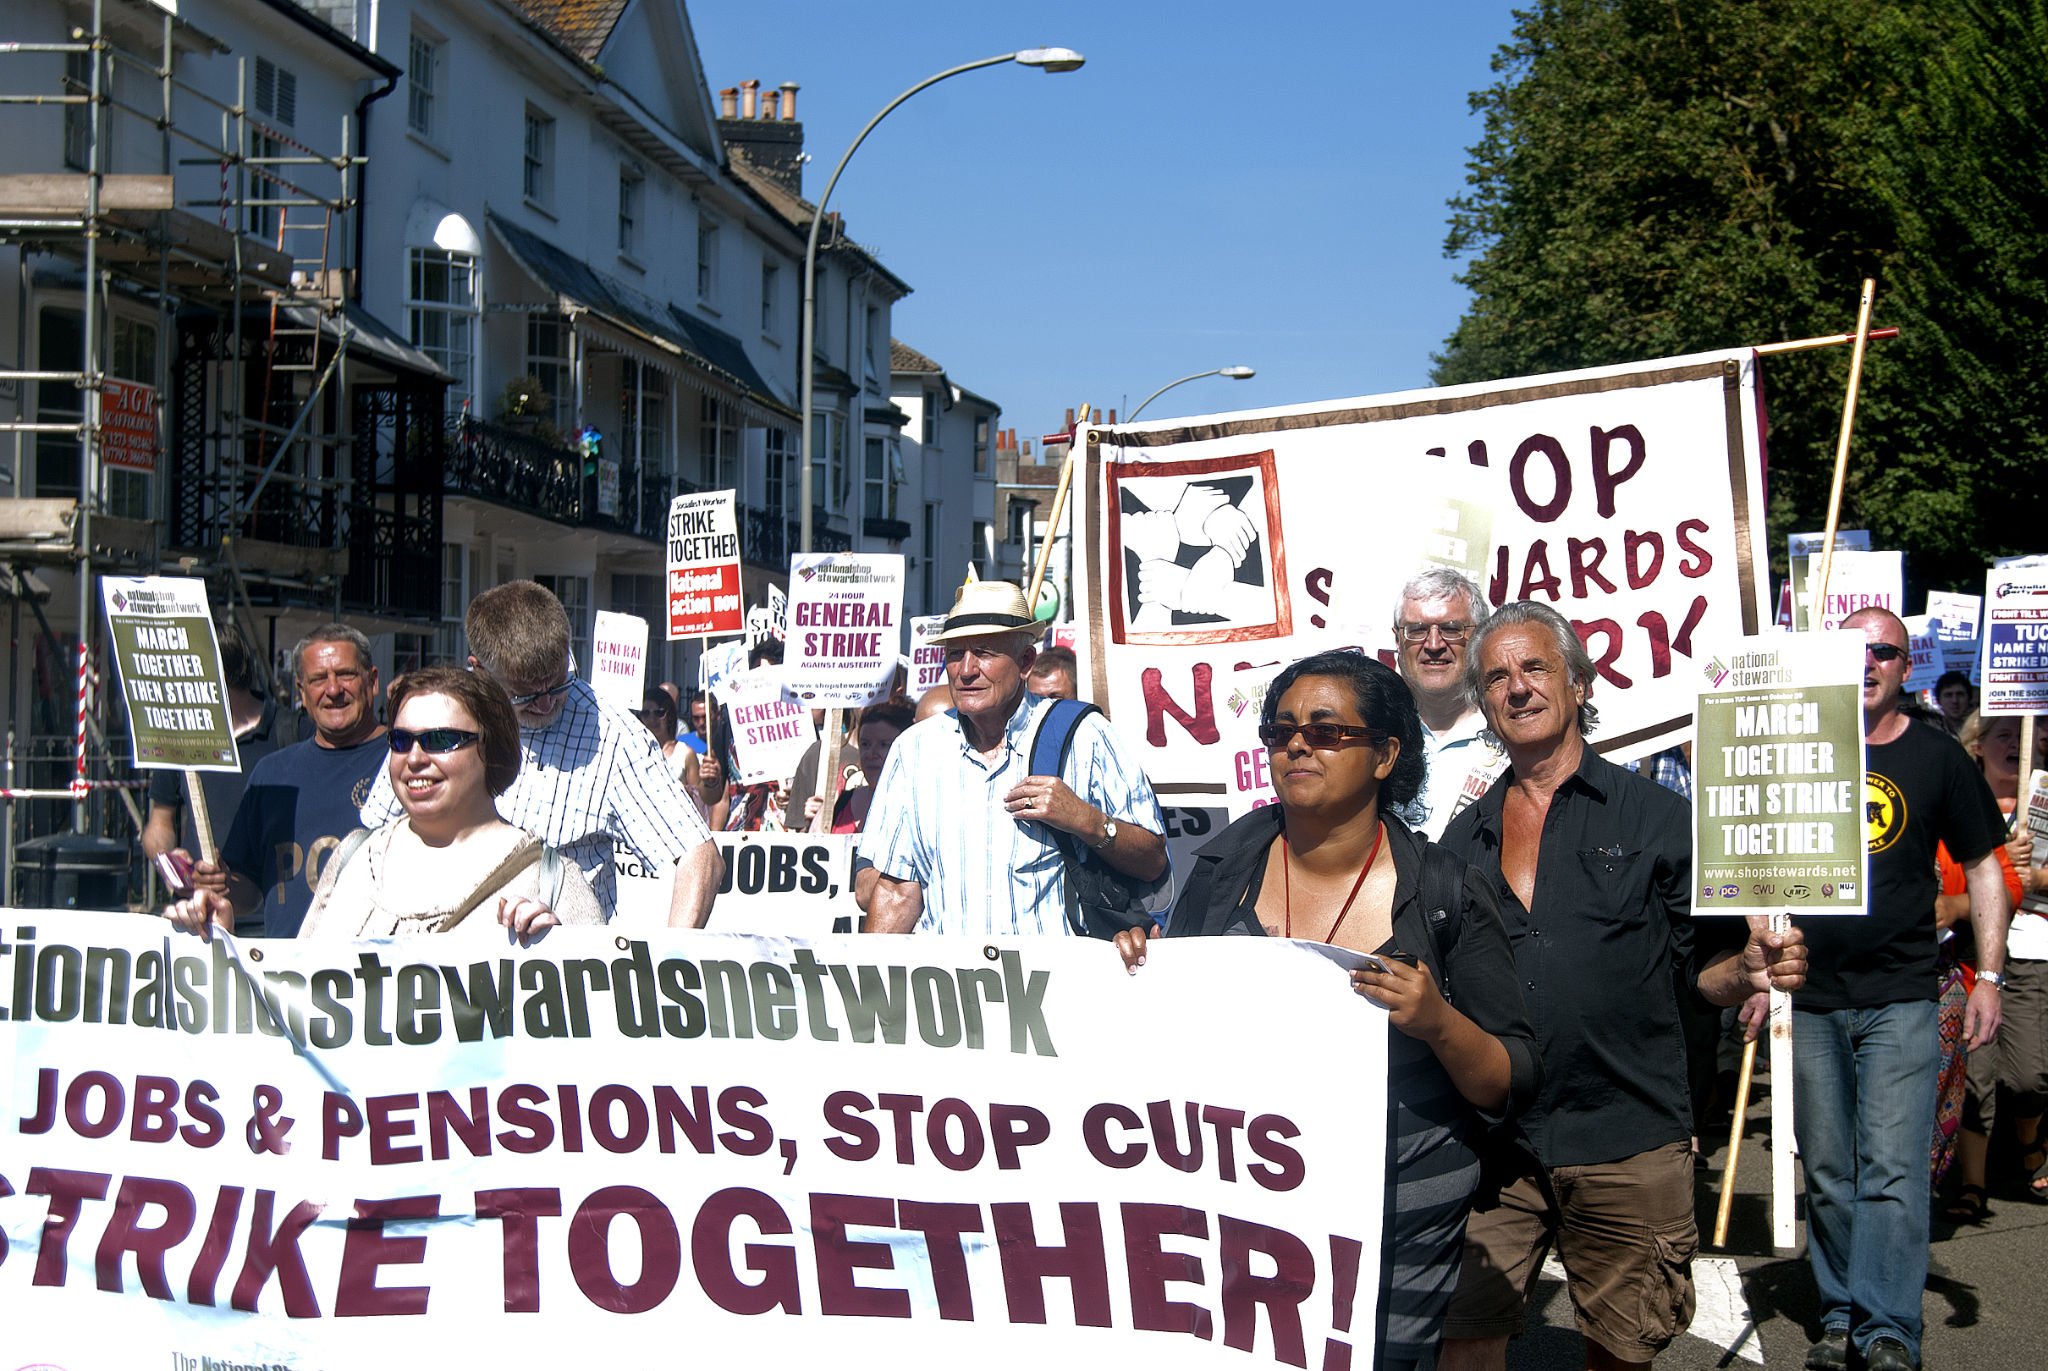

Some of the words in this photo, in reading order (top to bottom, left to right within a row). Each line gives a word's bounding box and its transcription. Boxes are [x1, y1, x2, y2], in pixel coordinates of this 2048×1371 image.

[670, 510, 715, 537] STRIKE
[670, 534, 737, 563] TOGETHER
[671, 568, 722, 593] National
[672, 593, 711, 616] action
[713, 594, 739, 613] now
[796, 602, 893, 627] GENERAL
[135, 626, 189, 650] MARCH
[804, 633, 882, 657] STRIKE
[2015, 624, 2048, 641] TUC
[1993, 642, 2034, 654] NAME
[133, 653, 205, 677] TOGETHER
[838, 661, 882, 669] AUSTERITY
[1992, 656, 2039, 668] STRIKE
[129, 680, 164, 703] THEN
[164, 681, 220, 704] STRIKE
[144, 706, 215, 731] TOGETHER
[735, 701, 805, 725] GENERAL
[1735, 702, 1820, 737] MARCH
[747, 720, 802, 745] STRIKE
[1722, 742, 1834, 777] TOGETHER
[1705, 784, 1760, 817] THEN
[1766, 781, 1852, 815] STRIKE
[1721, 822, 1835, 856] TOGETHER
[718, 845, 838, 900] JOBS,
[1704, 864, 1857, 880] www.shopstewards.net
[1721, 886, 1738, 897] pcs
[1752, 884, 1775, 895] CWU
[19, 1067, 226, 1149] JOBS
[246, 1084, 295, 1156] &
[321, 1084, 797, 1175] PENSIONS,
[823, 1090, 1051, 1171] STOP
[1082, 1099, 1306, 1192] CUTS
[474, 1185, 1362, 1371] TOGETHER!
